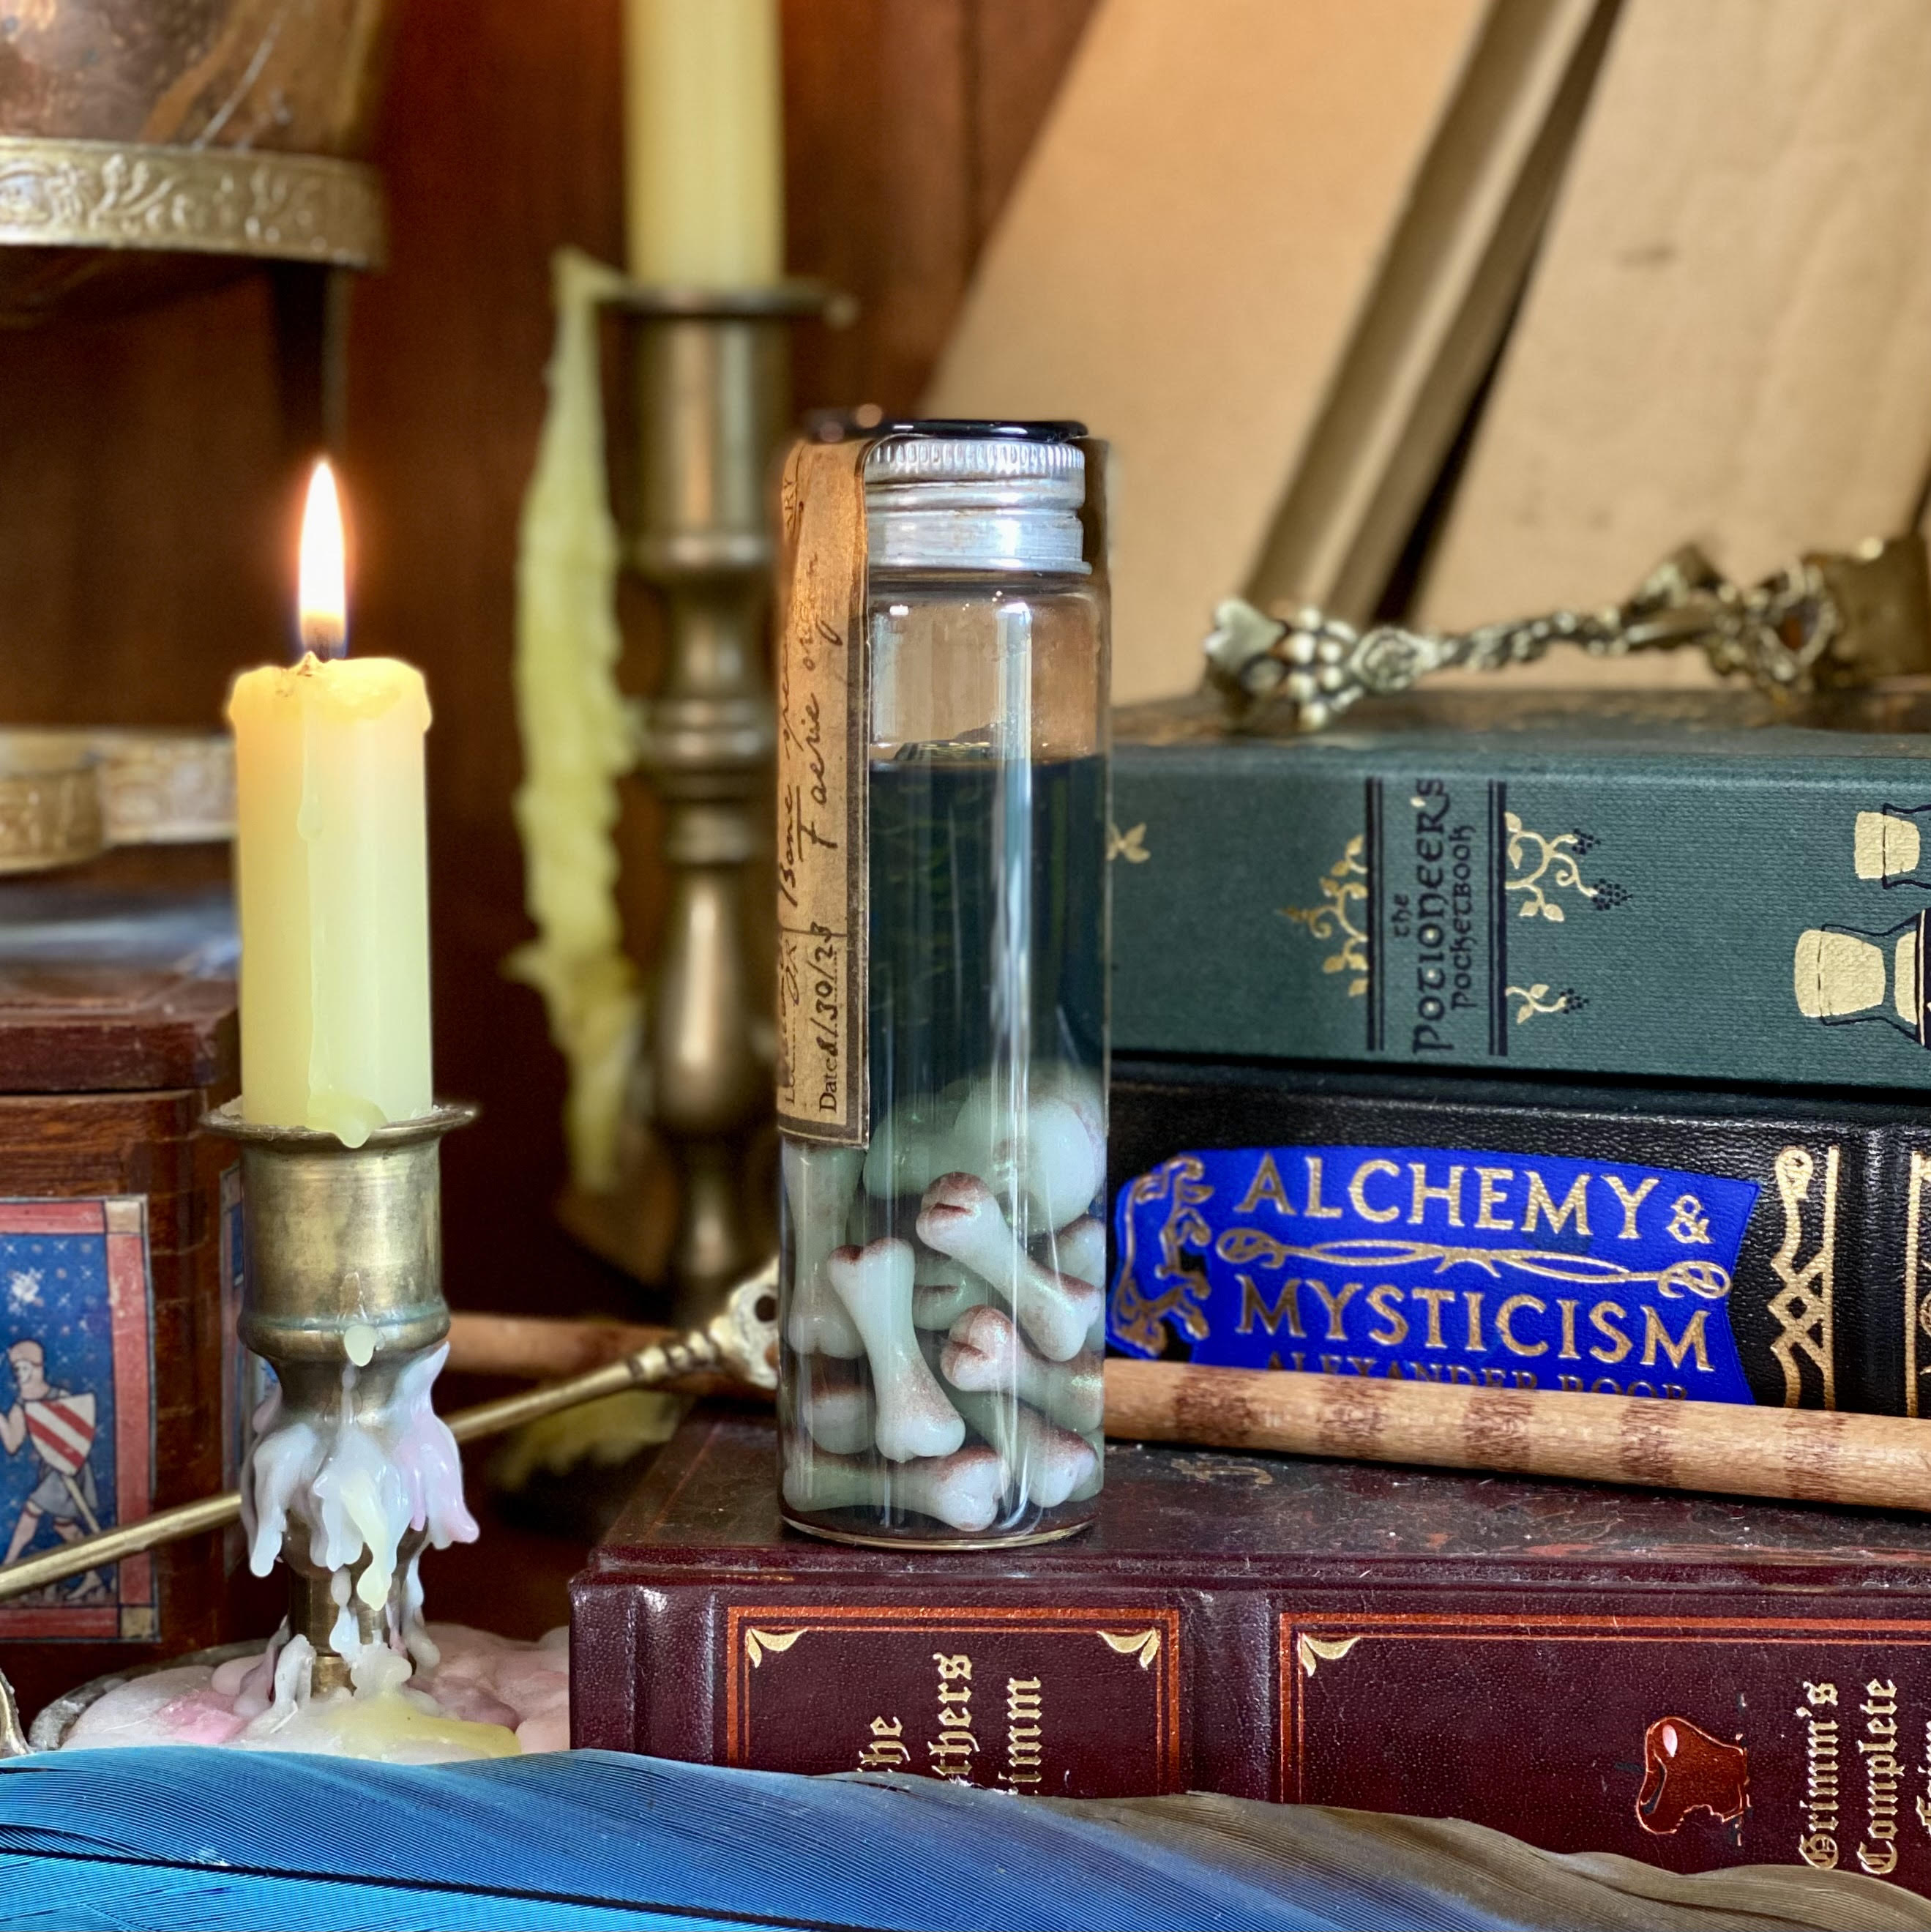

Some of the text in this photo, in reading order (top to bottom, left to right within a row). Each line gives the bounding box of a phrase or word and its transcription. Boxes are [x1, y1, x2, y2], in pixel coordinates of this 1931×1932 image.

[1233, 1155, 1711, 1246] ALCHEMY &
[1235, 1274, 1715, 1373] MYSTICISM
[857, 1715, 911, 1772] he
[1796, 1680, 1839, 1869] Grimm's
[1856, 1678, 1905, 1874] Complete
